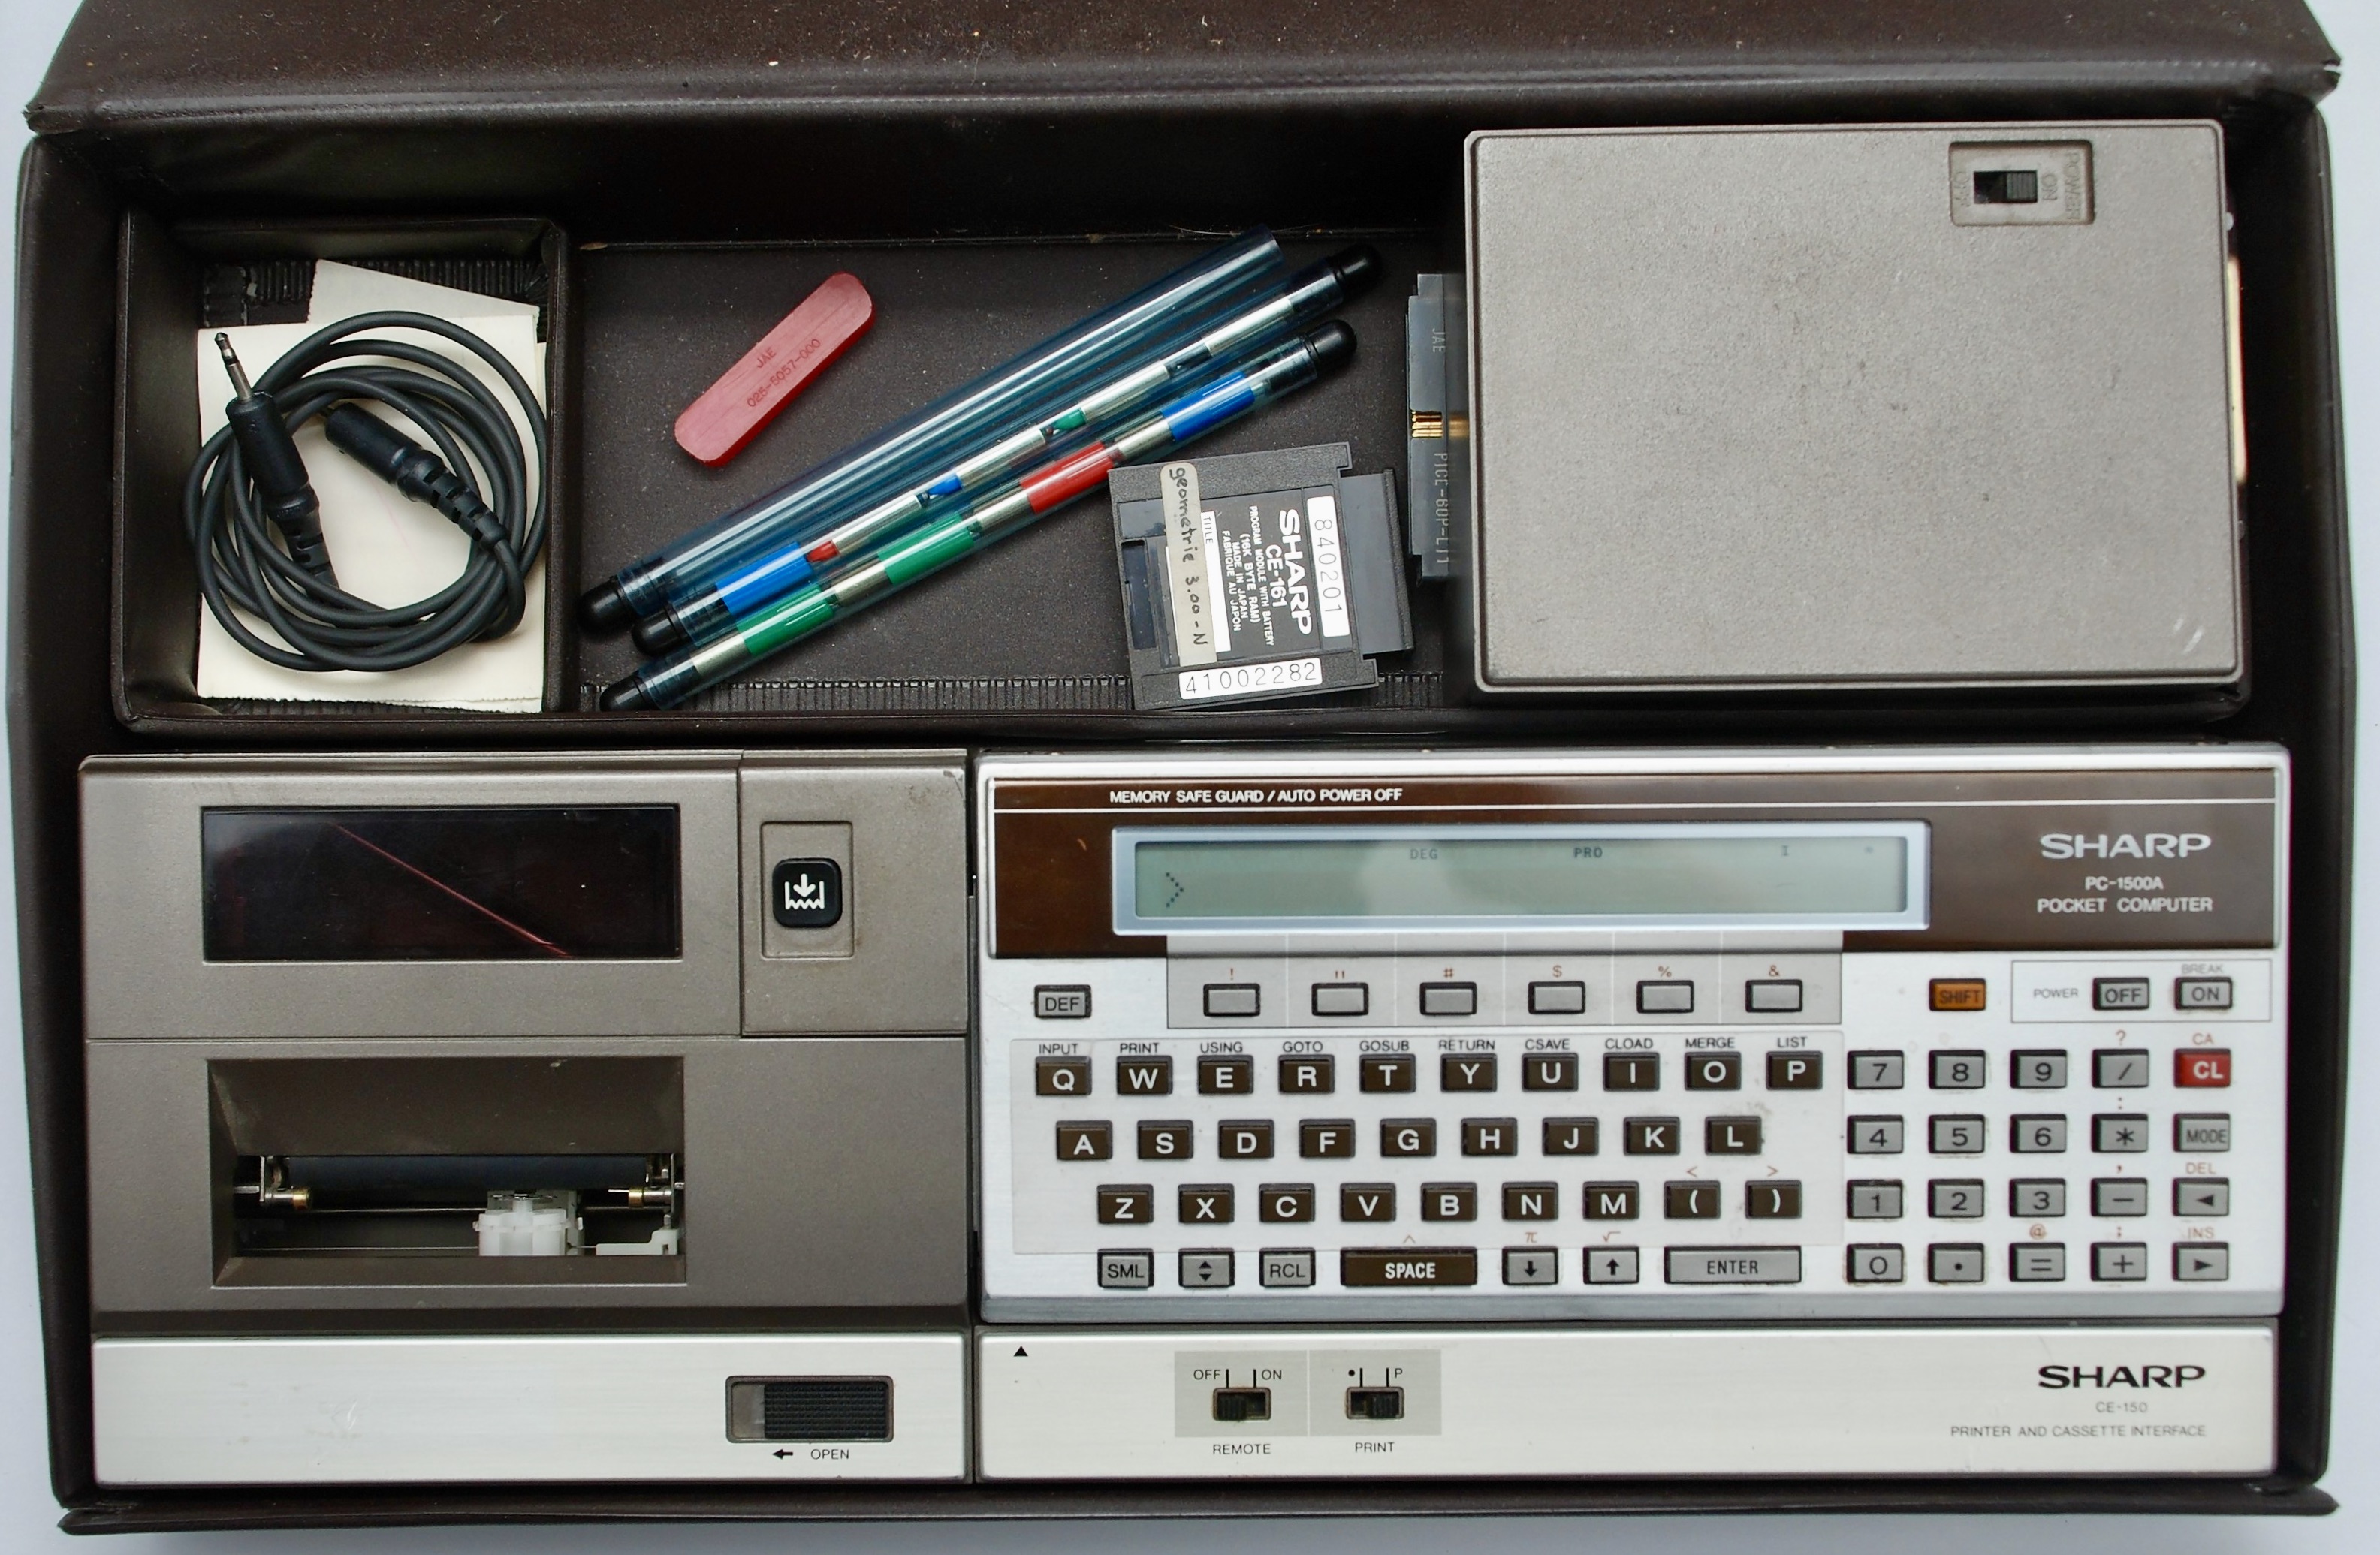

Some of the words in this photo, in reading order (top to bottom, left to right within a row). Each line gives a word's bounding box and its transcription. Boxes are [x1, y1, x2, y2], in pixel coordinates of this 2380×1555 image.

[756, 347, 777, 368] JAE
[747, 339, 821, 407] 025-5057-000
[1203, 517, 1213, 544] TITLE
[1250, 505, 1262, 545] PROGRAM
[1222, 530, 1235, 577] FABRIQUE
[1232, 542, 1242, 568] MADE
[1240, 533, 1251, 556] (16K
[1244, 562, 1256, 591] BYTE
[1255, 549, 1266, 583] MODULE
[1265, 544, 1287, 607] CE-161
[1279, 509, 1312, 635] SHARP
[1314, 519, 1343, 614] 840201
[1228, 582, 1237, 595] AU
[1235, 573, 1244, 583] IN
[1238, 589, 1248, 619] JAPAN
[1259, 586, 1269, 607] WITH
[1230, 601, 1241, 631] JAPON
[1248, 596, 1261, 623] RAM)
[1262, 610, 1274, 646] BATTERY
[1186, 662, 1317, 695] 41002282
[1109, 790, 1172, 803] MEMORY
[1175, 789, 1213, 803] SAFE
[1214, 789, 1265, 803] GUARD
[1277, 788, 1317, 803] AUTO
[1319, 788, 1372, 802] POWER
[1374, 788, 1403, 802] OFF
[1409, 847, 1440, 860] DEG
[1573, 846, 1603, 858] PRO
[2040, 833, 2212, 859] SHARP
[2085, 875, 2164, 891] PC-1500A
[2037, 897, 2107, 914] POCKET
[2116, 897, 2213, 913] COMPUTER
[2181, 963, 2224, 976] BREAK
[1045, 996, 1080, 1011] DEF
[1939, 990, 1980, 1003] SHIFT
[2033, 987, 2079, 999] POWER
[2105, 989, 2141, 1003] OFF
[2192, 987, 2219, 1001] ON
[1039, 1043, 1078, 1056] INPUT
[1119, 1042, 1159, 1053] PRINT
[1200, 1041, 1243, 1054] USING
[1282, 1041, 1323, 1053] GOTO
[1359, 1040, 1410, 1052] GOSUB
[1438, 1039, 1495, 1051] RETURN
[1525, 1038, 1569, 1050] CSAVE
[1604, 1038, 1654, 1050] CLOAD
[1685, 1037, 1734, 1049] MERGE
[1777, 1036, 1807, 1048] LIST
[2192, 1032, 2214, 1046] CA
[1052, 1068, 1075, 1092] Q
[1128, 1068, 1159, 1089] W
[1215, 1067, 1234, 1089] E
[1297, 1065, 1317, 1087] R
[1378, 1065, 1398, 1086] T
[1459, 1062, 1480, 1085] Y
[1541, 1062, 1561, 1084] U
[1630, 1062, 1636, 1083] I
[1703, 1060, 1727, 1083] O
[1787, 1060, 1806, 1082] P
[1872, 1062, 1888, 1082] 7
[1951, 1062, 1970, 1083] 8
[2035, 1062, 2053, 1083] 9
[2193, 1061, 2224, 1080] CL
[1073, 1133, 1095, 1156] A
[1155, 1132, 1175, 1155] S
[1236, 1132, 1257, 1153] D
[1319, 1132, 1337, 1153] F
[1397, 1129, 1419, 1151] G
[1480, 1128, 1501, 1150] H
[1563, 1127, 1579, 1150] J
[1645, 1126, 1665, 1148] K
[1727, 1126, 1744, 1147] L
[1869, 1128, 1888, 1147] 4
[1952, 1127, 1968, 1147] 5
[2035, 1126, 2052, 1147] 6
[2187, 1129, 2226, 1144] MODE
[2185, 1162, 2216, 1175] DEL
[1115, 1198, 1134, 1219] Z
[1196, 1197, 1216, 1219] X
[1275, 1195, 1298, 1218] C
[1358, 1195, 1379, 1216] V
[1440, 1194, 1460, 1216] B
[1521, 1194, 1542, 1216] N
[1600, 1192, 1627, 1215] M
[1871, 1194, 1881, 1213] 1
[1950, 1192, 1968, 1211] 2
[2033, 1190, 2050, 1210] 3
[2187, 1226, 2215, 1239] INS
[1107, 1264, 1145, 1279] SML
[1269, 1263, 1305, 1279] RCL
[1385, 1261, 1436, 1279] SPACE
[1707, 1259, 1759, 1275] ENTER
[1193, 1369, 1221, 1381] OFF
[1261, 1369, 1282, 1381] ON
[1394, 1367, 1403, 1379] P
[2038, 1364, 2206, 1389] SHARP
[2095, 1400, 2148, 1414] CE-150
[1950, 1425, 2011, 1437] PRINTER
[2018, 1426, 2047, 1437] AND
[2052, 1425, 2125, 1437] CASSETTE
[2131, 1424, 2205, 1437] INTERFACE
[810, 1448, 849, 1460] OPEN
[1212, 1443, 1271, 1455] REMOTE
[1355, 1442, 1395, 1453] PRINT
